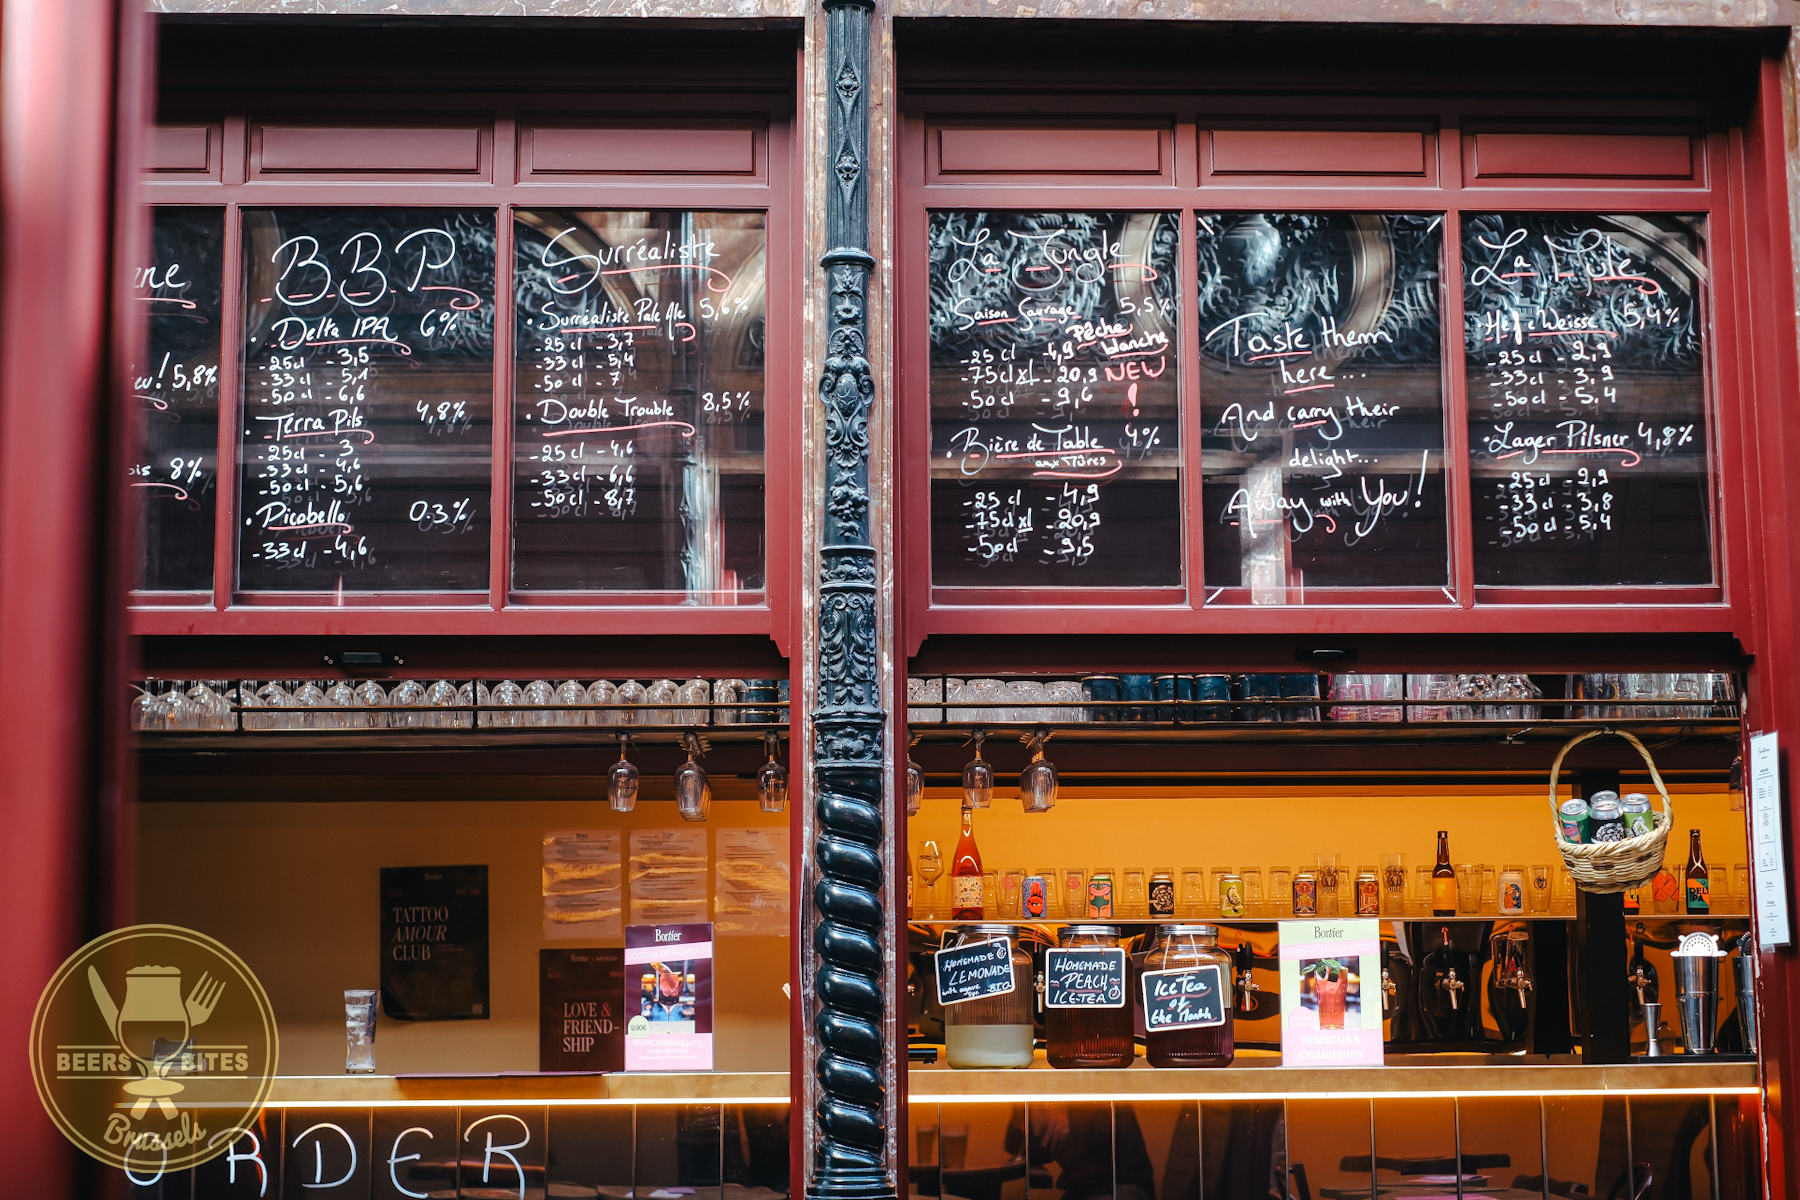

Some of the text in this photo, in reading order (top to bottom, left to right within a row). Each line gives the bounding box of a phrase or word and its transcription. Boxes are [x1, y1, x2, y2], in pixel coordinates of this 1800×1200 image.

[542, 228, 720, 294] Surréaliste
[948, 228, 1130, 293] La Jungle
[1471, 228, 1645, 296] La Mule
[540, 296, 750, 341] Surréaliste Pale Ale 5,6%
[954, 298, 1008, 330] Saison
[1119, 297, 1170, 316] 5,5%
[1622, 303, 1680, 329] 5,4%
[271, 309, 459, 349] Delta IPA 6%
[1066, 320, 1130, 341] Pêche
[1205, 312, 1393, 356] Taste them
[1101, 330, 1169, 355] blanche
[172, 364, 218, 390] 5,8%
[1104, 356, 1166, 382] NEW
[256, 400, 466, 441] Terra Pils 4,8%
[537, 392, 750, 424] Double Trouble 8,5%
[1222, 396, 1399, 441] And carry their
[951, 422, 1160, 477] Bière de Table 4%
[1488, 420, 1693, 465] Lager Pilsner 4,8%
[170, 457, 202, 484] 8%
[256, 501, 346, 531] Picobello
[1228, 488, 1314, 539] Away
[1320, 491, 1351, 508] with
[393, 906, 449, 923] TATTOO
[392, 925, 447, 942] AMOUR
[655, 929, 681, 942] Bortier
[1314, 926, 1344, 939] Bortier
[393, 945, 431, 961] CLUB
[627, 952, 660, 960] COCKTAIL
[685, 947, 710, 955] MONTH
[943, 953, 994, 972] HOMEMADE
[949, 964, 1010, 986] LEMONADE
[1061, 973, 1108, 991] PEACH
[942, 987, 957, 996] with
[1053, 991, 1107, 1004] ICE-TEA
[564, 1002, 611, 1018] LOVE &
[563, 1038, 594, 1052] SHIP
[1302, 1035, 1360, 1044] HIBISCUS &
[1300, 1050, 1364, 1059] CRANBERRY
